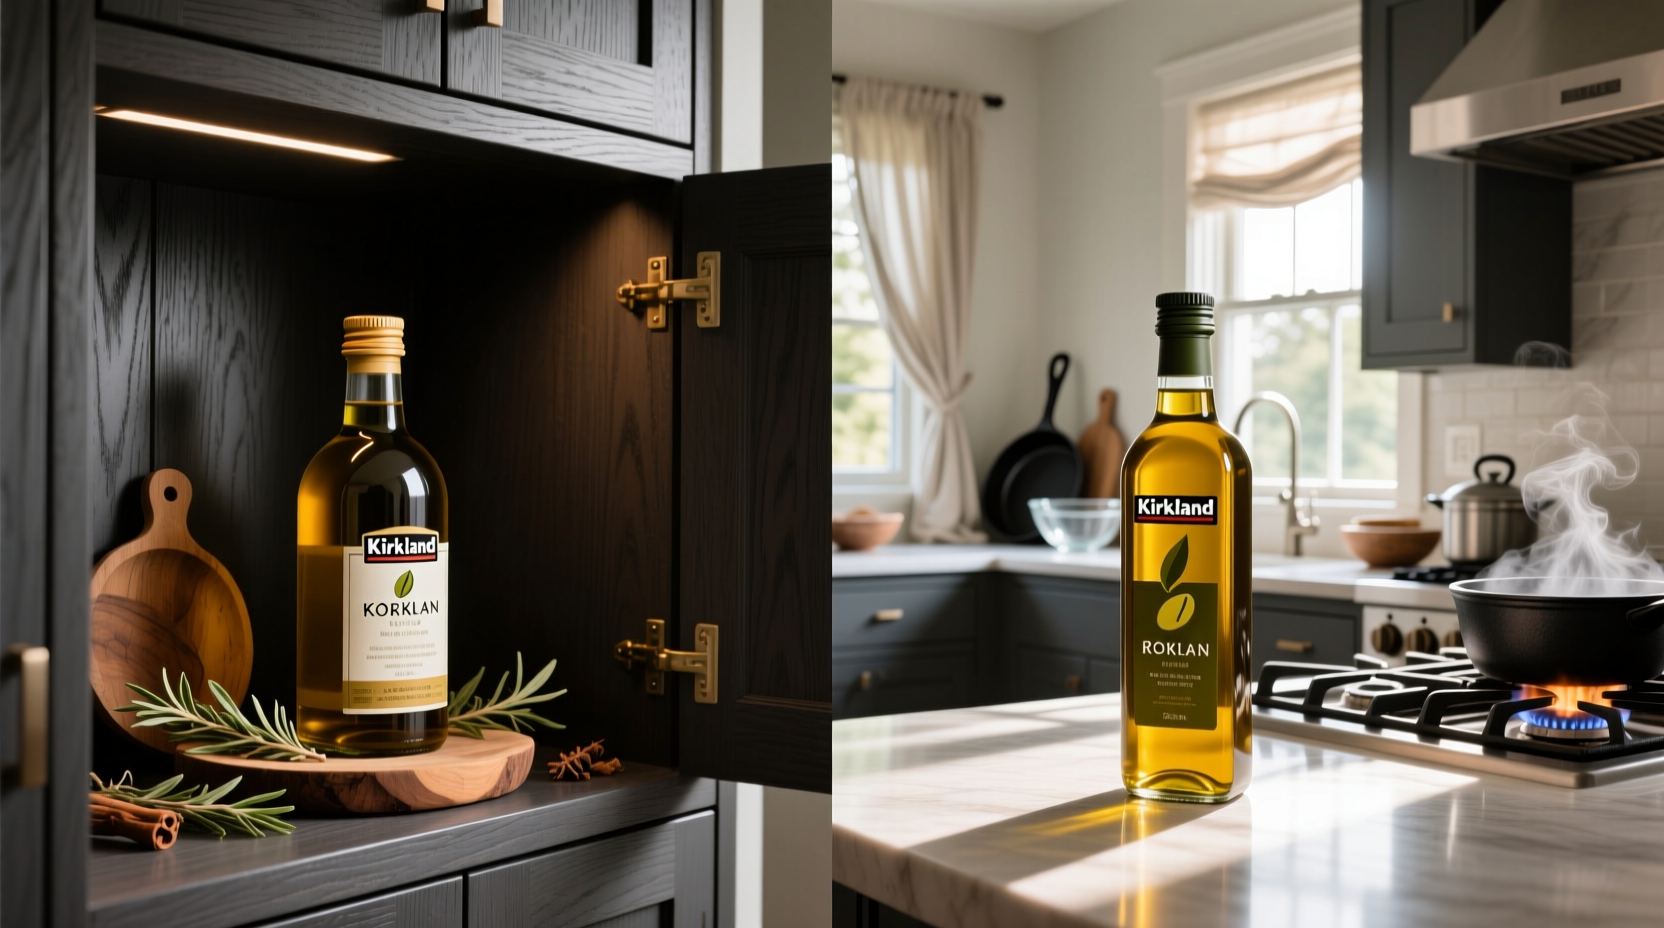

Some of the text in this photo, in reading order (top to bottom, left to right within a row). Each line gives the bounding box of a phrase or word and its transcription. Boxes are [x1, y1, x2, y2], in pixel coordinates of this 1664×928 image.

[1137, 498, 1214, 516] Kirkland
[367, 536, 436, 555] Kirkland
[363, 600, 439, 617] KORKLAN
[1142, 640, 1209, 657] ROKLAN
